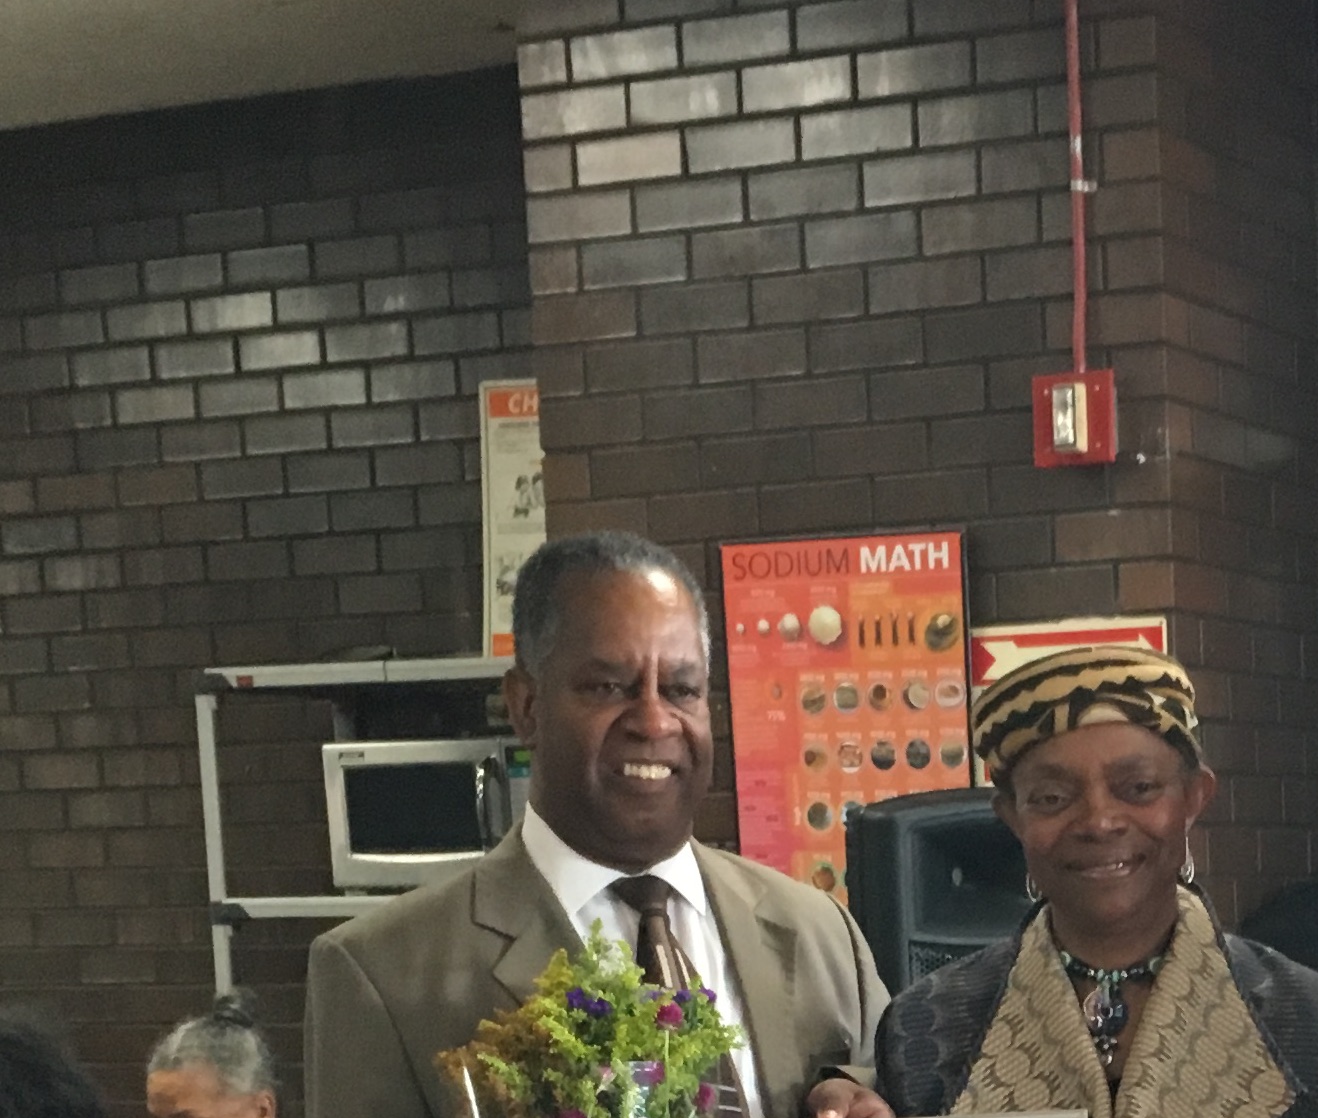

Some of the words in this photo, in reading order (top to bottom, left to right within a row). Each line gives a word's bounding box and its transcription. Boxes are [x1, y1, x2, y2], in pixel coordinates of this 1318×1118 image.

[508, 393, 539, 414] CH
[732, 547, 850, 581] SODIUM
[859, 541, 950, 574] MATH
